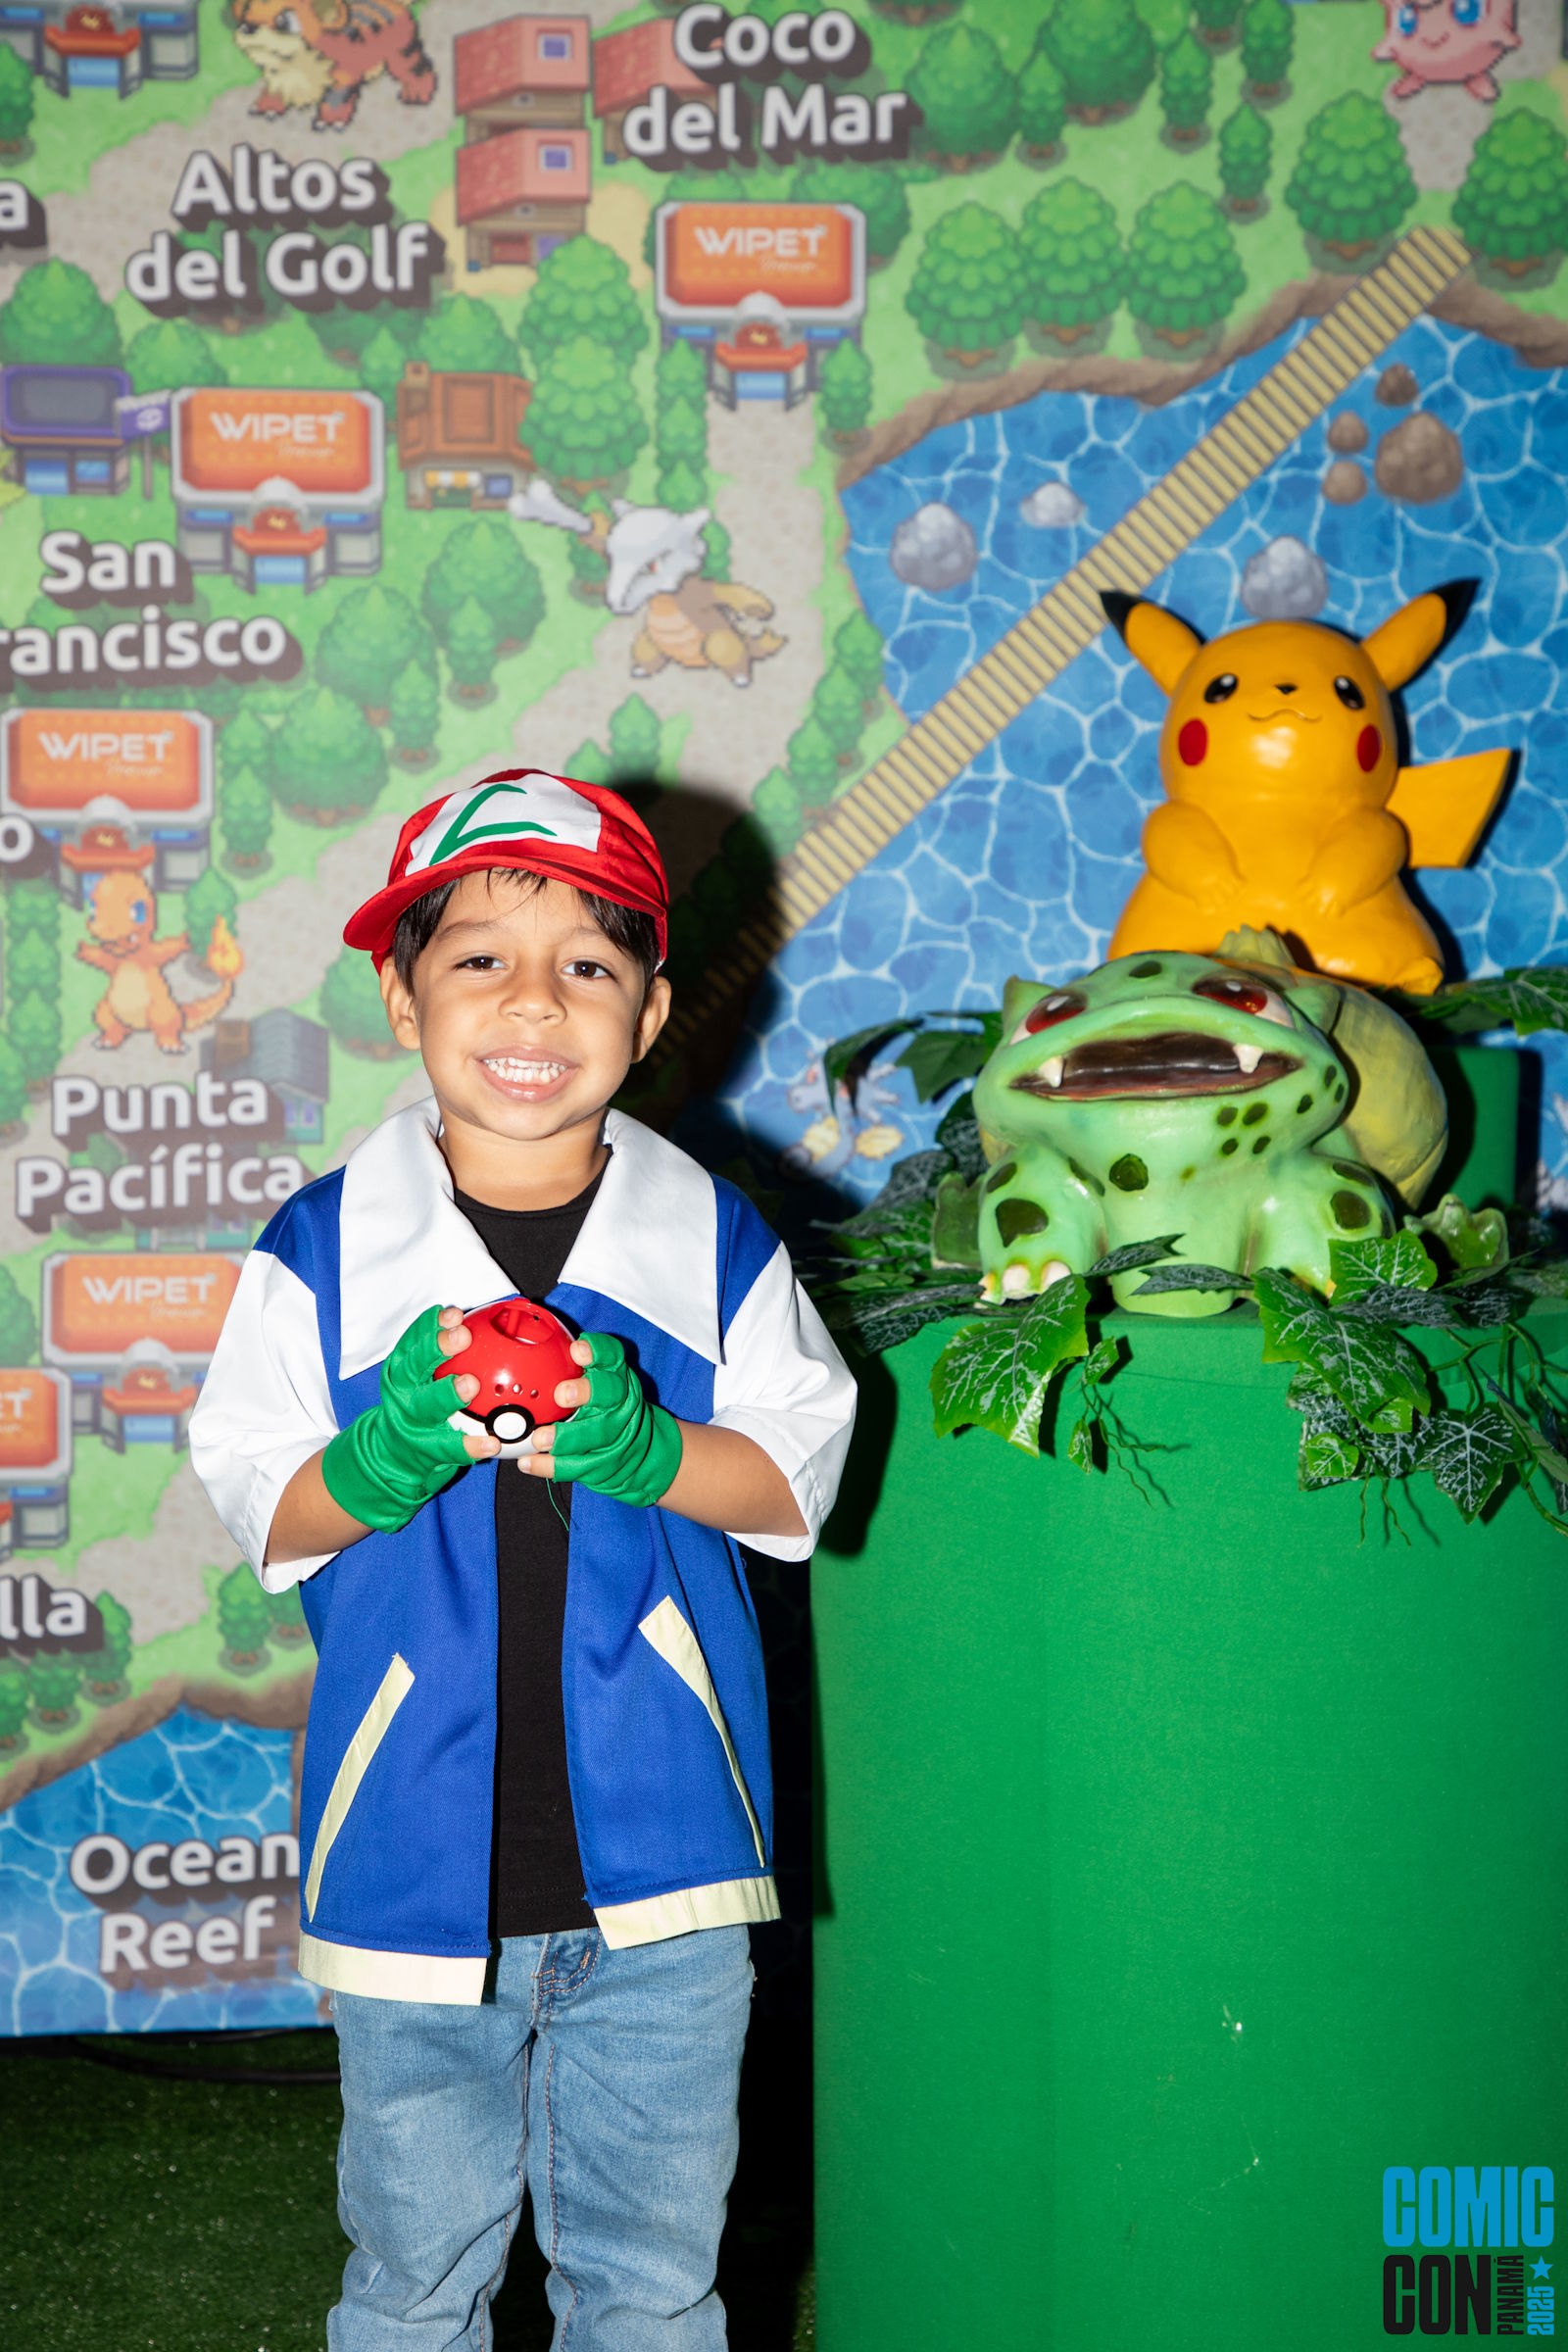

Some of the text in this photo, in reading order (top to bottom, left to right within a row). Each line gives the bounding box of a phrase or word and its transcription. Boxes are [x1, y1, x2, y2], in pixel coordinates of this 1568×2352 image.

[673, 3, 856, 69] Coco
[622, 82, 907, 155] del Mar
[172, 144, 376, 216] Altos
[125, 222, 429, 302] del Golf
[694, 226, 827, 257] WIPET
[210, 411, 345, 443] WIPET
[40, 531, 175, 593] San
[38, 731, 173, 761] WIPET
[53, 1072, 268, 1135] Punta
[17, 1143, 304, 1217] Pacífica
[82, 1274, 217, 1304] WIPET
[70, 1834, 300, 1894] Ocean
[101, 1894, 276, 1974] Reef
